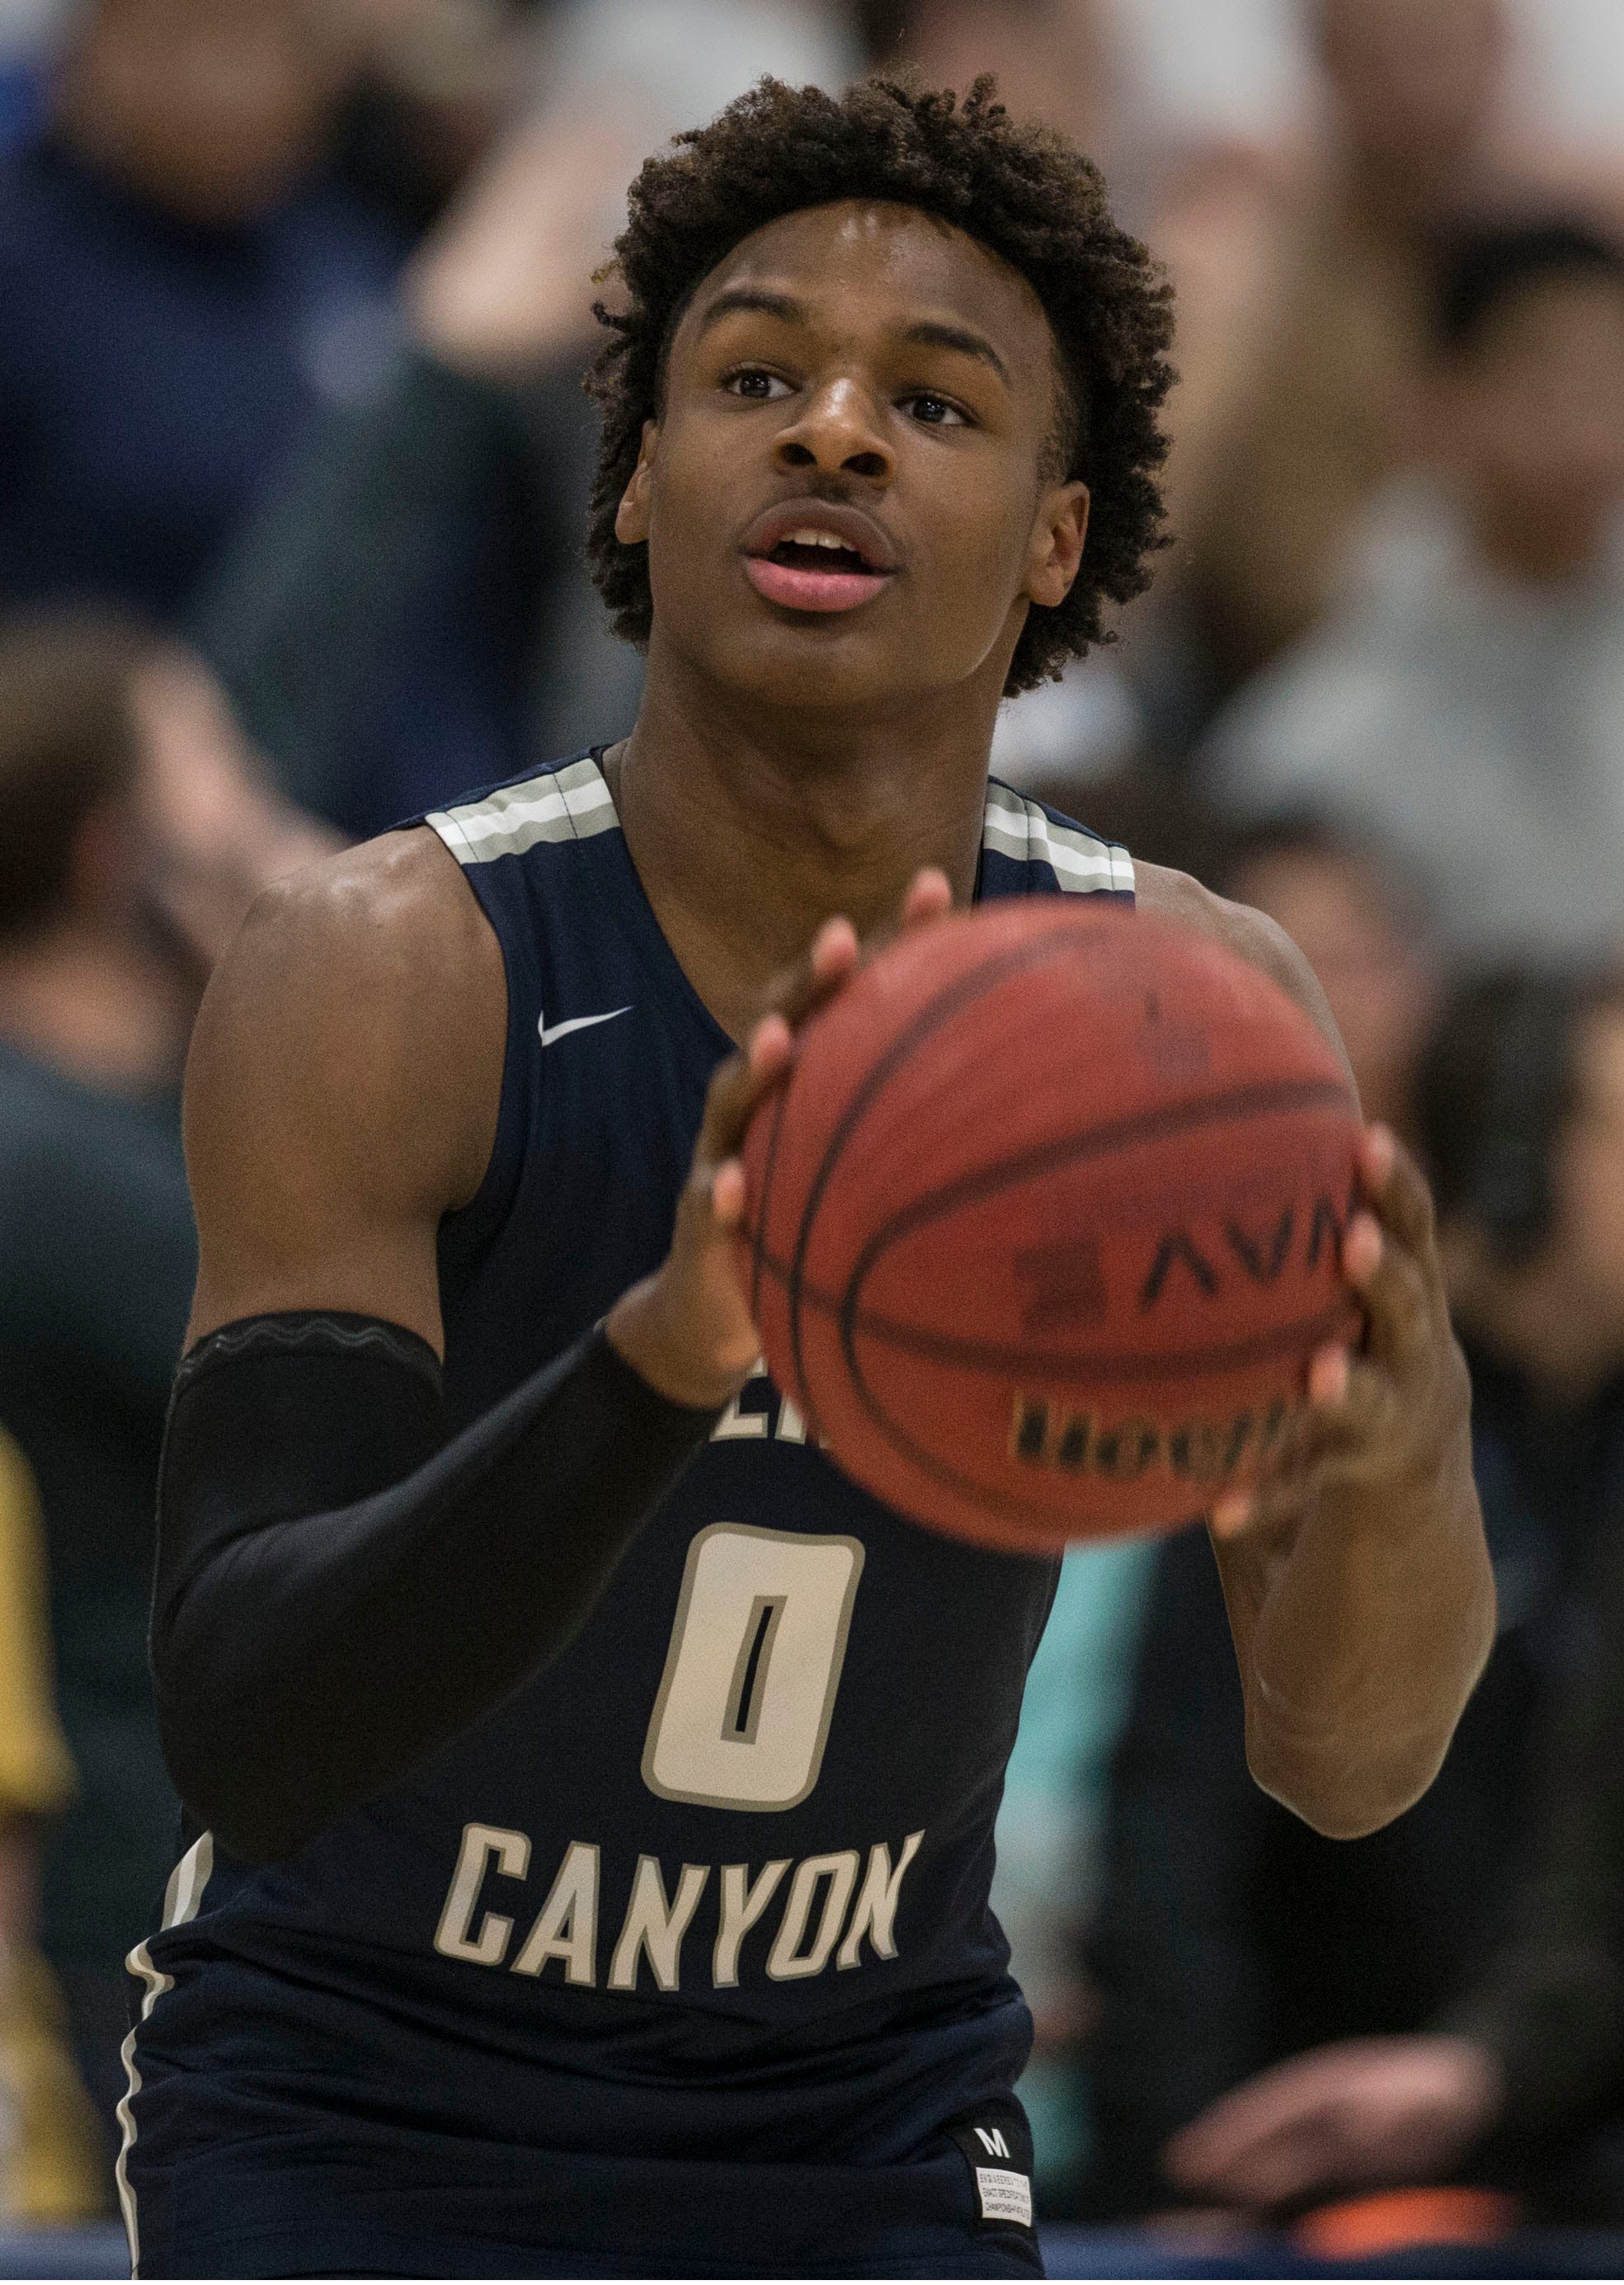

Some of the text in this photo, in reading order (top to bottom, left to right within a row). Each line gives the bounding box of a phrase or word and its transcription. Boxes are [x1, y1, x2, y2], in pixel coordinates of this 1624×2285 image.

[640, 1522, 866, 1812] 0
[434, 1822, 925, 1991] CANYON
[974, 2127, 1010, 2158] M
